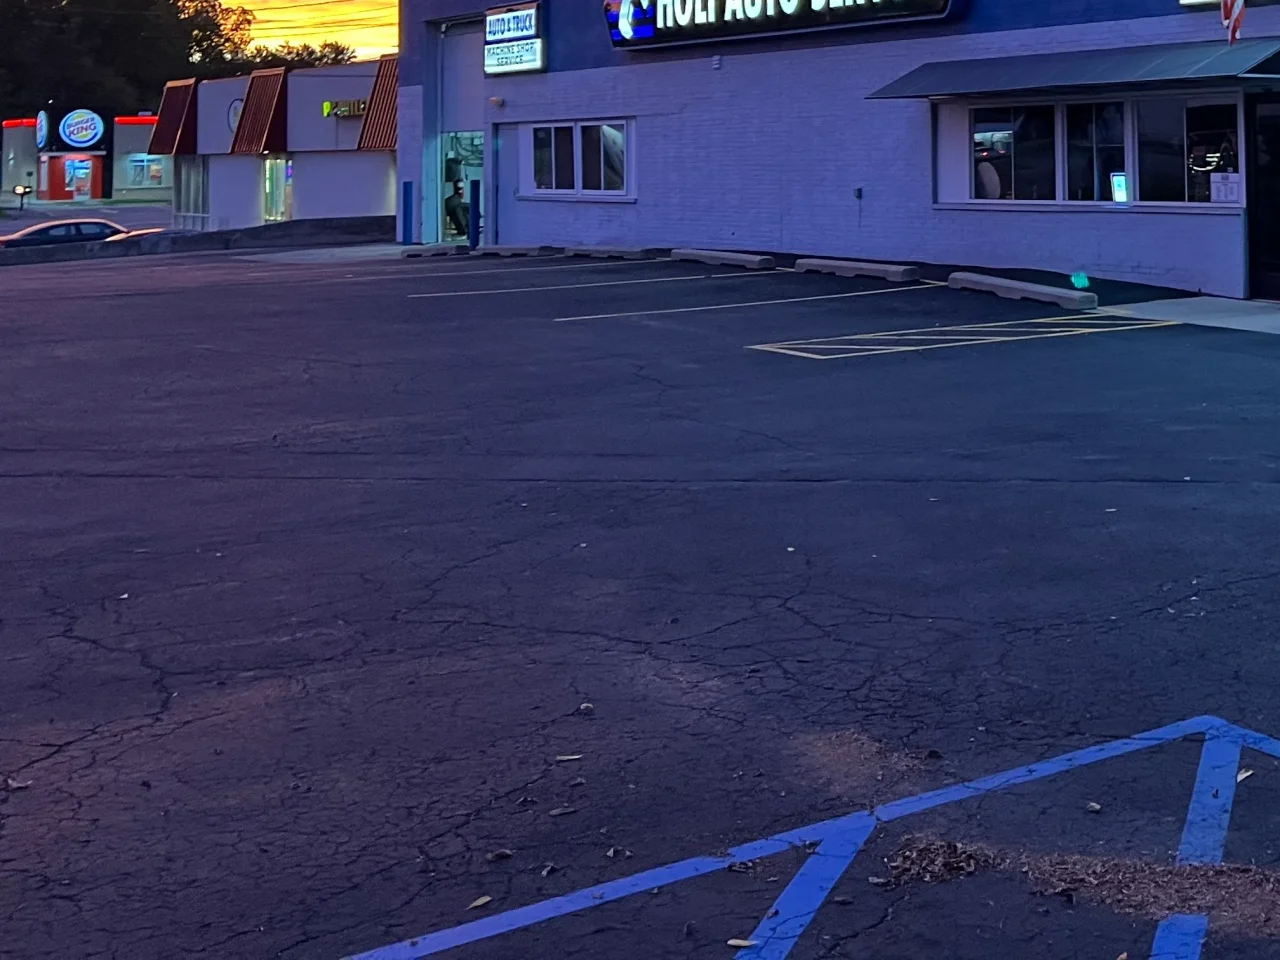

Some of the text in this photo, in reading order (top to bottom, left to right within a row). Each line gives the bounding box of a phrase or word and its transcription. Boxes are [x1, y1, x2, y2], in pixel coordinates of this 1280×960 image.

[488, 17, 505, 36] AUTO
[512, 13, 533, 33] TRUCK
[516, 42, 534, 54] SHOP
[496, 54, 524, 67] SERVICE
[66, 116, 95, 130] BURGER
[68, 122, 97, 139] KING
